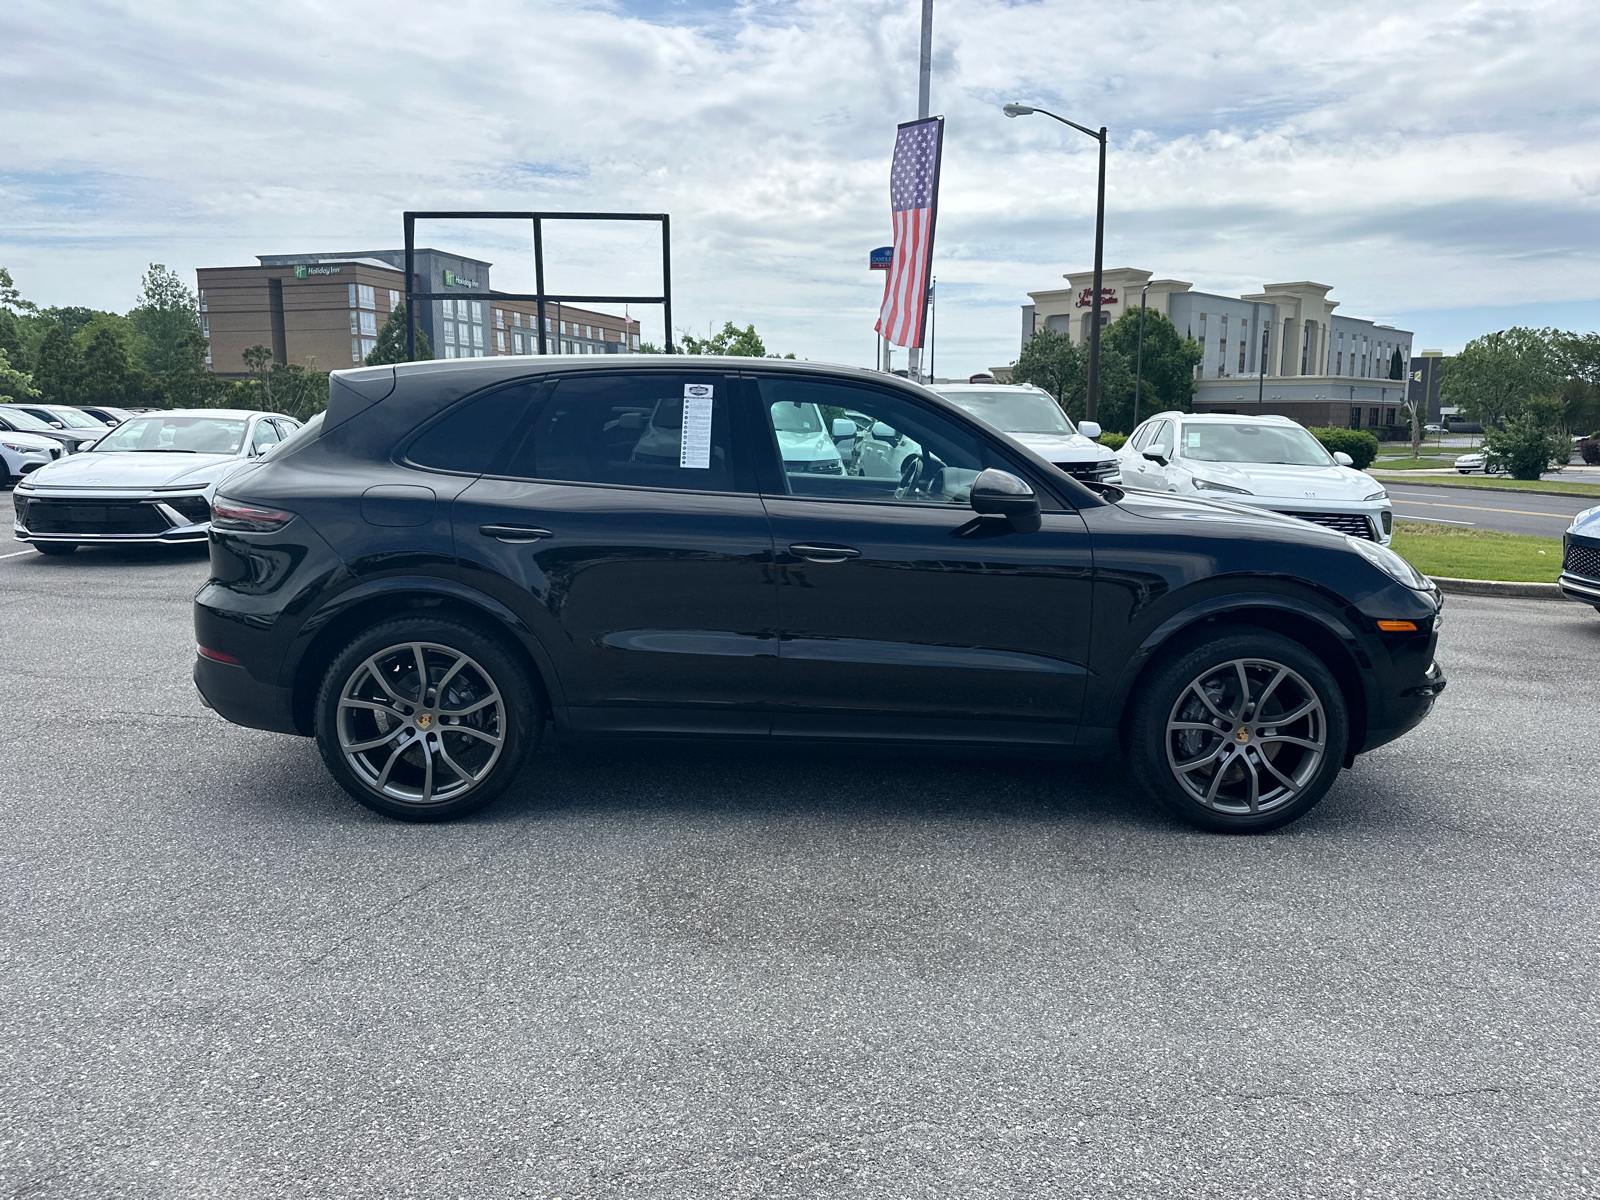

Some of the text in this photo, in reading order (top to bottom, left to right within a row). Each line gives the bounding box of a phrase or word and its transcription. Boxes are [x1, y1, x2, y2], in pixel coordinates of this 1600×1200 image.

[308, 267, 330, 275] Holiday
[455, 275, 472, 288] Holiday
[1079, 288, 1116, 299] Haton
[1076, 298, 1092, 308] Inn
